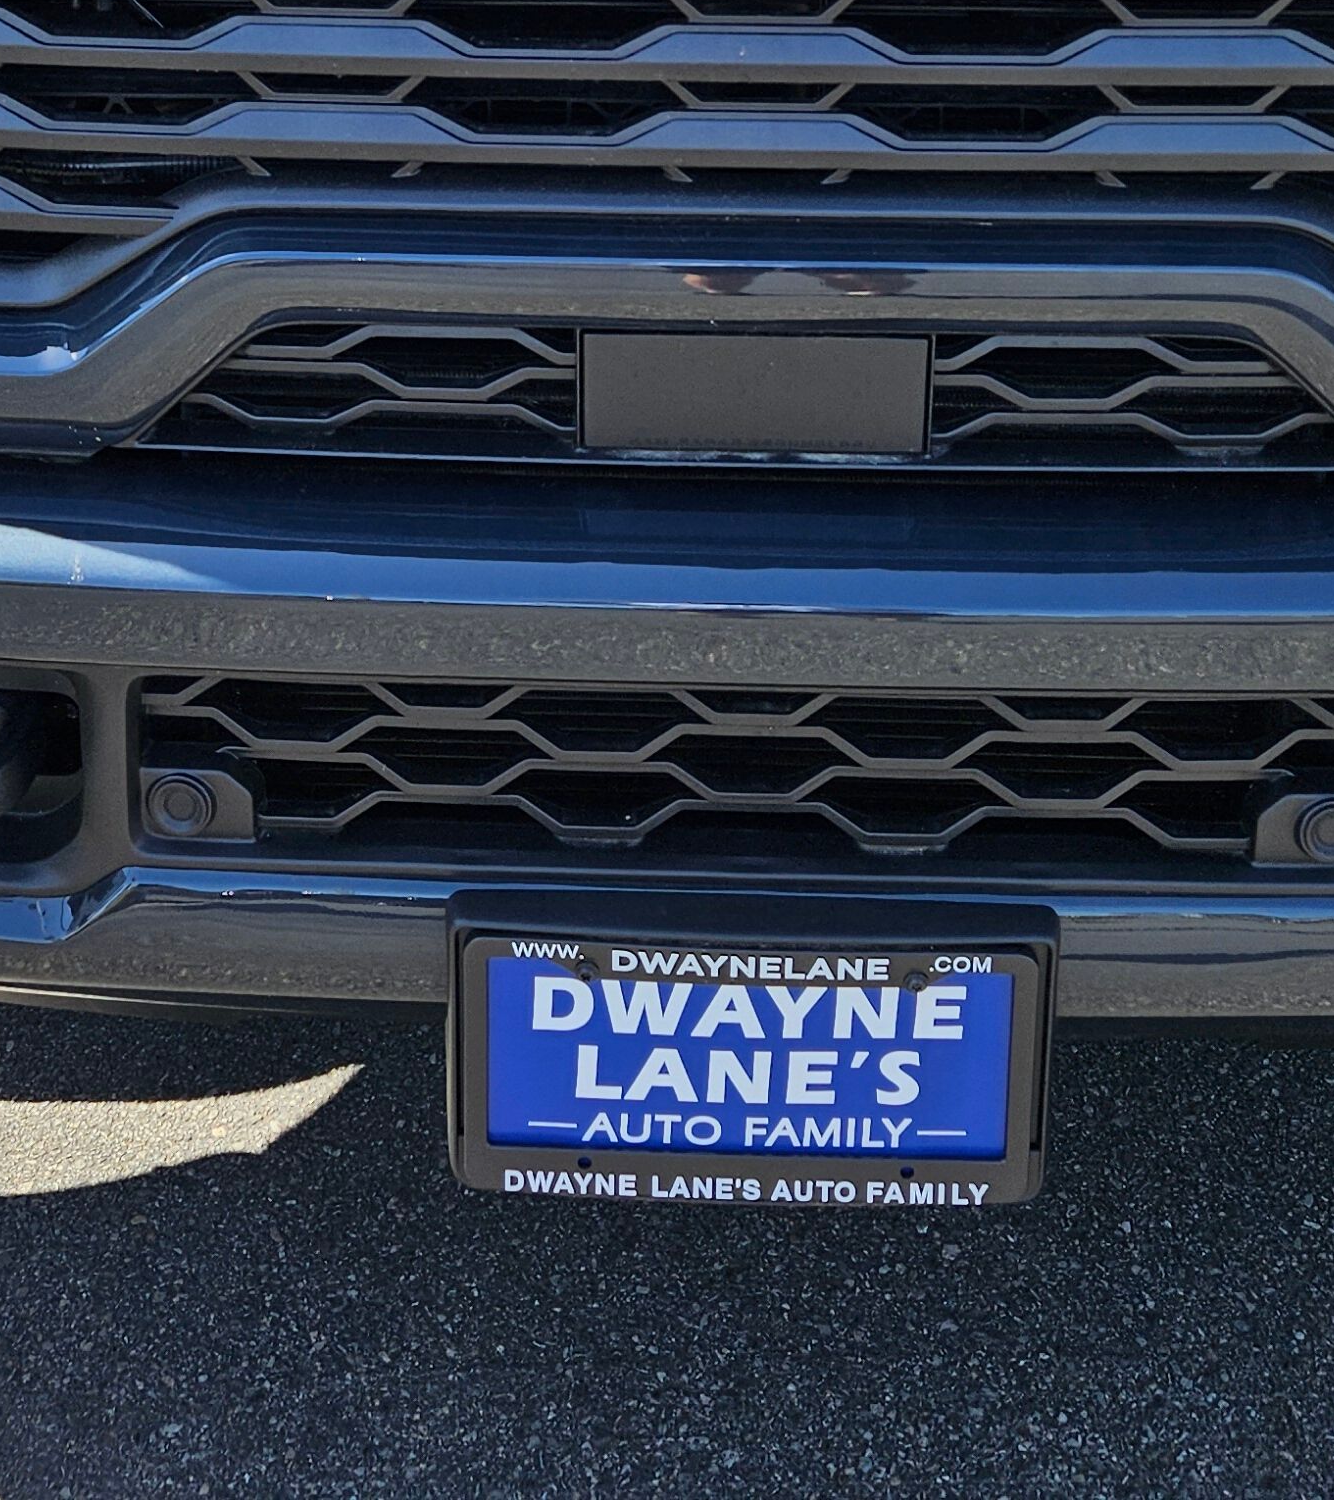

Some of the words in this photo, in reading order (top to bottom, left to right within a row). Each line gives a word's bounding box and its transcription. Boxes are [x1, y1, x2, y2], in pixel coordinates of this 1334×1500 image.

[610, 950, 891, 981] DWAYNELANE
[928, 955, 993, 974] .COM
[531, 975, 968, 1040] DWAYNE
[574, 1044, 921, 1106] LANE'S
[580, 1111, 723, 1146] AUTO
[743, 1116, 913, 1148] FAMILY
[503, 1168, 639, 1198] DWAYNE
[650, 1174, 763, 1201] LANE'S
[769, 1178, 857, 1204] AUTO
[865, 1181, 990, 1206] FAMILY
